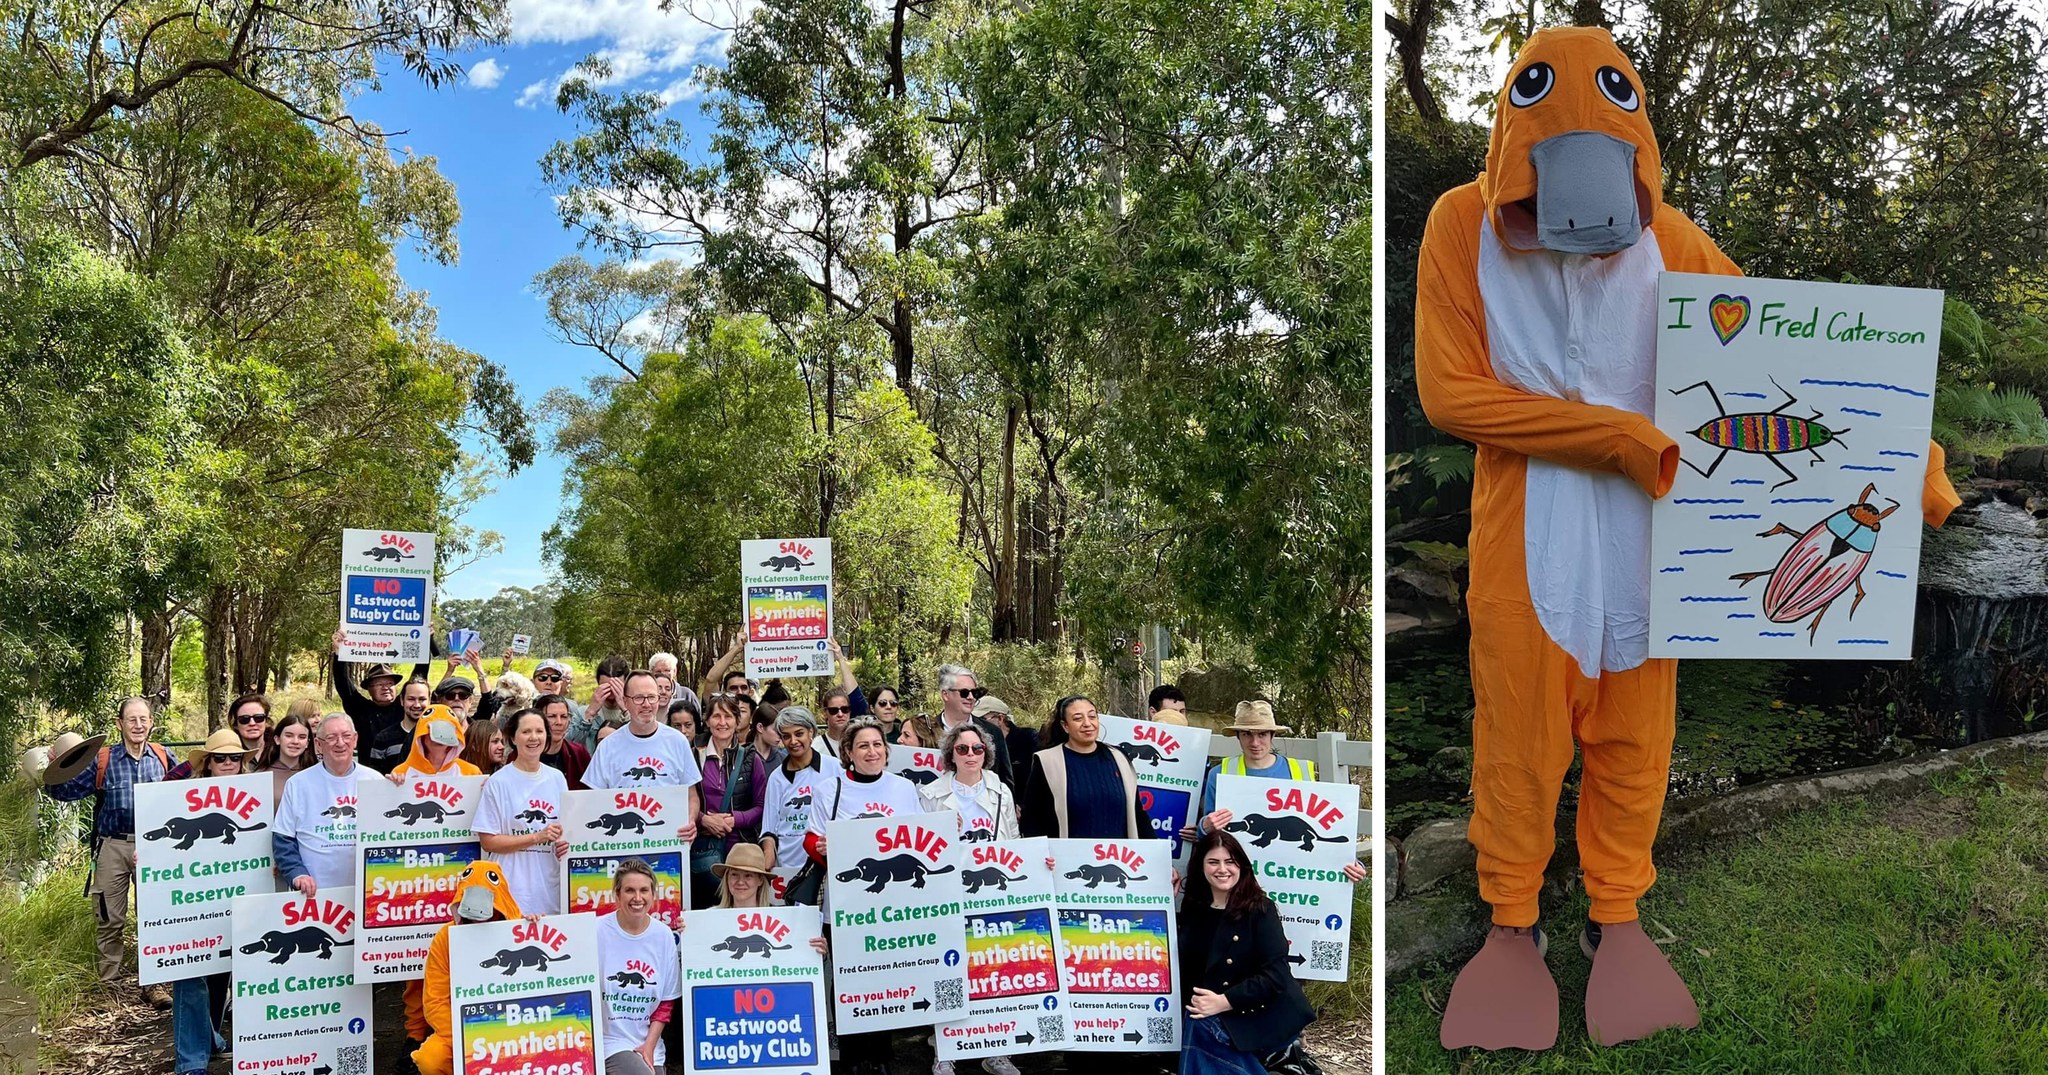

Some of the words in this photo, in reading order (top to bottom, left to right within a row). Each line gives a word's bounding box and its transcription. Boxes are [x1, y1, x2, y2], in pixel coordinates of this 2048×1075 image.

[1667, 297, 1697, 330] I
[1759, 303, 1818, 338] Fred
[1826, 312, 1925, 345] Caterson
[381, 534, 415, 553] SAVE
[779, 542, 813, 560] SAVE
[345, 564, 362, 572] Fred
[400, 567, 431, 575] Reserve
[373, 579, 401, 594] NO
[775, 588, 803, 602] Ban
[354, 594, 416, 608] Eastwood
[350, 608, 389, 621] Rugby
[393, 610, 420, 621] Club
[754, 605, 822, 622] Synthetic
[758, 624, 820, 638] Surfaces
[372, 641, 392, 649] help?
[1133, 725, 1180, 755] SAVE
[638, 757, 664, 770] SAVE
[1156, 774, 1199, 787] Reserve
[185, 786, 260, 820] SAVE
[336, 796, 357, 805] SAV
[414, 781, 463, 807] SAVE
[529, 800, 554, 814] SAVE
[615, 792, 662, 818] SAVE
[865, 802, 894, 817] SAVE
[1266, 788, 1344, 831] SAVE
[316, 823, 334, 832] Fred
[360, 831, 386, 842] Fred
[389, 829, 439, 841] Caterson
[569, 844, 588, 852] red
[592, 841, 640, 851] Caterson
[875, 825, 948, 862] SAVE
[368, 849, 386, 857] 79.5
[404, 850, 444, 868] Ban
[972, 847, 1023, 873] SAVE
[1093, 844, 1145, 872] SAVE
[141, 863, 184, 883] Fred
[189, 855, 271, 877] Caterson
[571, 859, 589, 867] 79.5
[171, 885, 245, 905] Reserve
[1007, 893, 1051, 905] Reserve
[1071, 893, 1123, 904] Caterson
[1126, 894, 1170, 904] Reserve
[1269, 891, 1320, 906] serve
[144, 919, 162, 928] Fred
[164, 915, 198, 926] Caterson
[199, 911, 223, 920] Action
[282, 899, 355, 934] SAVE
[835, 909, 877, 927] Fred
[882, 901, 960, 923] Caterson
[1297, 917, 1320, 925] Group
[737, 913, 790, 942] SAVE
[972, 919, 1014, 938] Ban
[1088, 914, 1130, 934] Ban
[143, 946, 167, 956] Can
[169, 942, 190, 957] you
[192, 935, 223, 950] help?
[384, 933, 414, 941] Caterson
[512, 922, 567, 952] SAVE
[865, 932, 936, 952] Reserve
[157, 956, 184, 968] Scan
[187, 952, 211, 963] here
[362, 952, 382, 961] Can
[384, 951, 404, 963] you
[406, 948, 430, 961] help
[968, 940, 1047, 966] nthetic
[373, 965, 398, 974] Scan
[400, 963, 423, 972] here
[627, 960, 654, 978] SAVE
[687, 968, 712, 980] Fred
[716, 968, 769, 978] Caterson
[772, 966, 819, 976] Reserve
[858, 964, 891, 973] Caterson
[893, 960, 916, 969] Action
[918, 957, 939, 967] Group
[237, 978, 279, 997] Fred
[284, 973, 354, 992] Caterso
[455, 985, 484, 999] Fred
[488, 979, 544, 995] Caterson
[547, 974, 595, 988] Reserve
[969, 971, 1047, 994] urfaces
[1066, 967, 1160, 988] Surfaces
[734, 989, 775, 1014] NO
[840, 994, 860, 1004] Can
[863, 992, 884, 1005] you
[886, 986, 916, 1000] help?
[266, 1002, 341, 1021] Reserve
[465, 1006, 485, 1015] 79.5
[505, 1004, 552, 1026] Ban
[613, 1004, 645, 1013] Reserve
[853, 1006, 879, 1017] Scan
[882, 1004, 905, 1014] here
[705, 1015, 802, 1036] Eastwood
[943, 1025, 964, 1037] Can
[967, 1024, 988, 1039] you
[990, 1021, 1016, 1034] help?
[1075, 1020, 1094, 1030] you
[1096, 1018, 1126, 1029] help?
[258, 1031, 293, 1041] Caterson
[294, 1028, 318, 1037] Action
[320, 1026, 343, 1034] Group
[1092, 1033, 1115, 1043] here
[472, 1027, 586, 1064] Synthetic
[700, 1040, 762, 1064] Rugby
[768, 1038, 811, 1058] Club
[957, 1040, 981, 1050] Scan
[983, 1038, 1007, 1048] here
[238, 1060, 260, 1070] Can
[263, 1060, 284, 1073] you
[287, 1052, 318, 1067] help?
